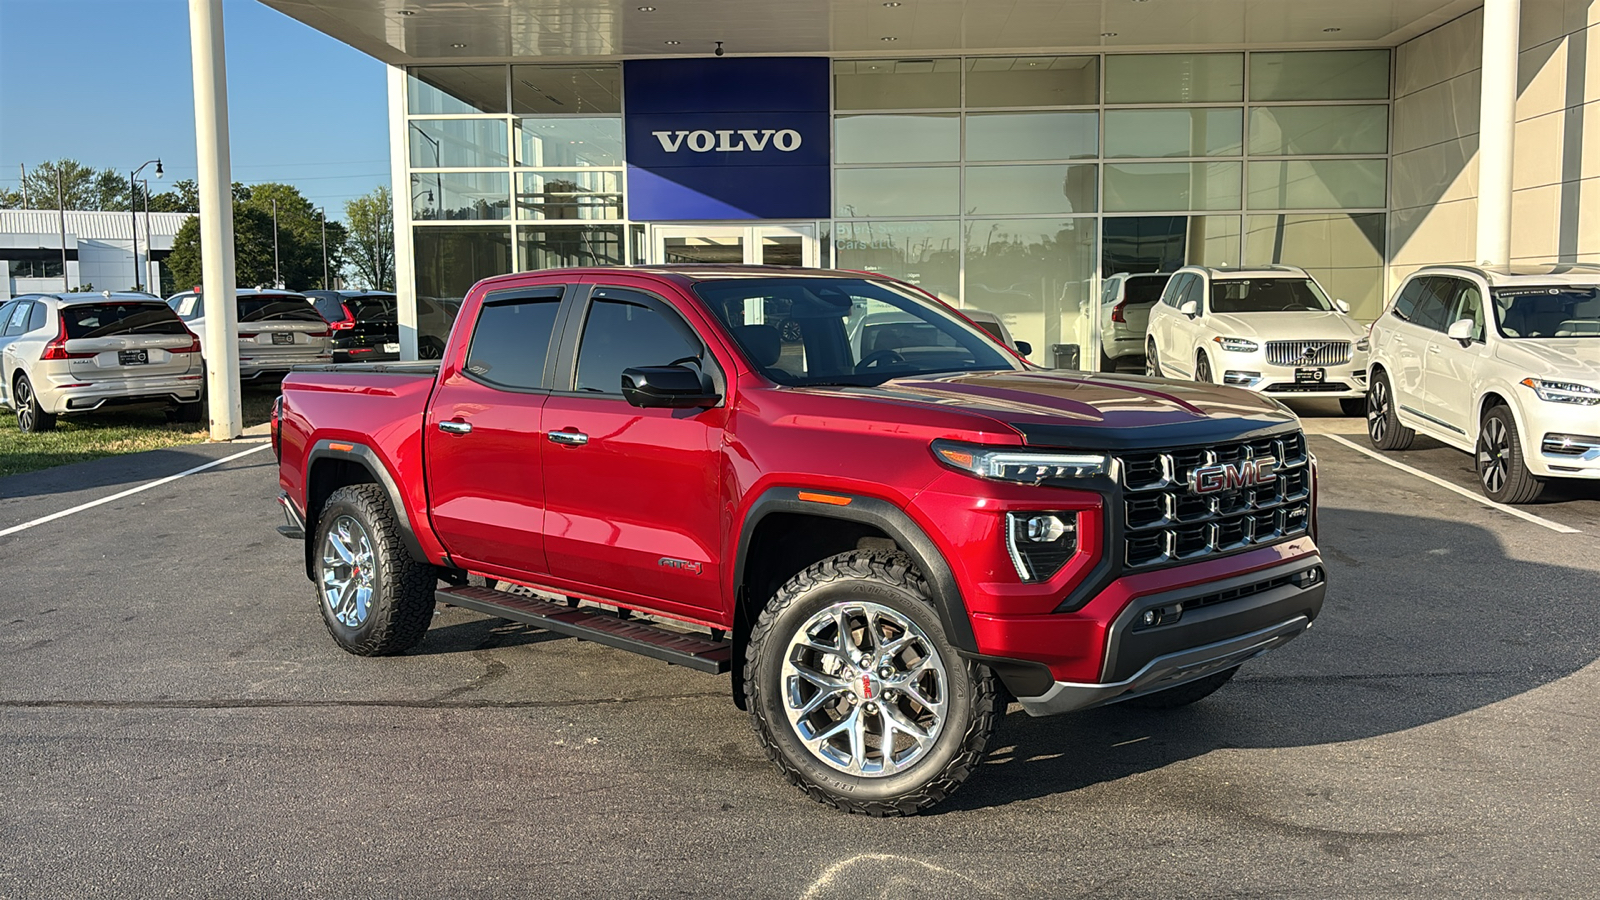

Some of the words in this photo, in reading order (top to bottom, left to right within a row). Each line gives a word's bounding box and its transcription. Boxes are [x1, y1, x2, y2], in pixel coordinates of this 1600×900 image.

[652, 129, 802, 153] VOLVO
[837, 224, 873, 238] Byers
[837, 239, 867, 250] Cars
[1193, 457, 1276, 495] GMC
[658, 556, 703, 576] AT4
[862, 674, 873, 699] GMC
